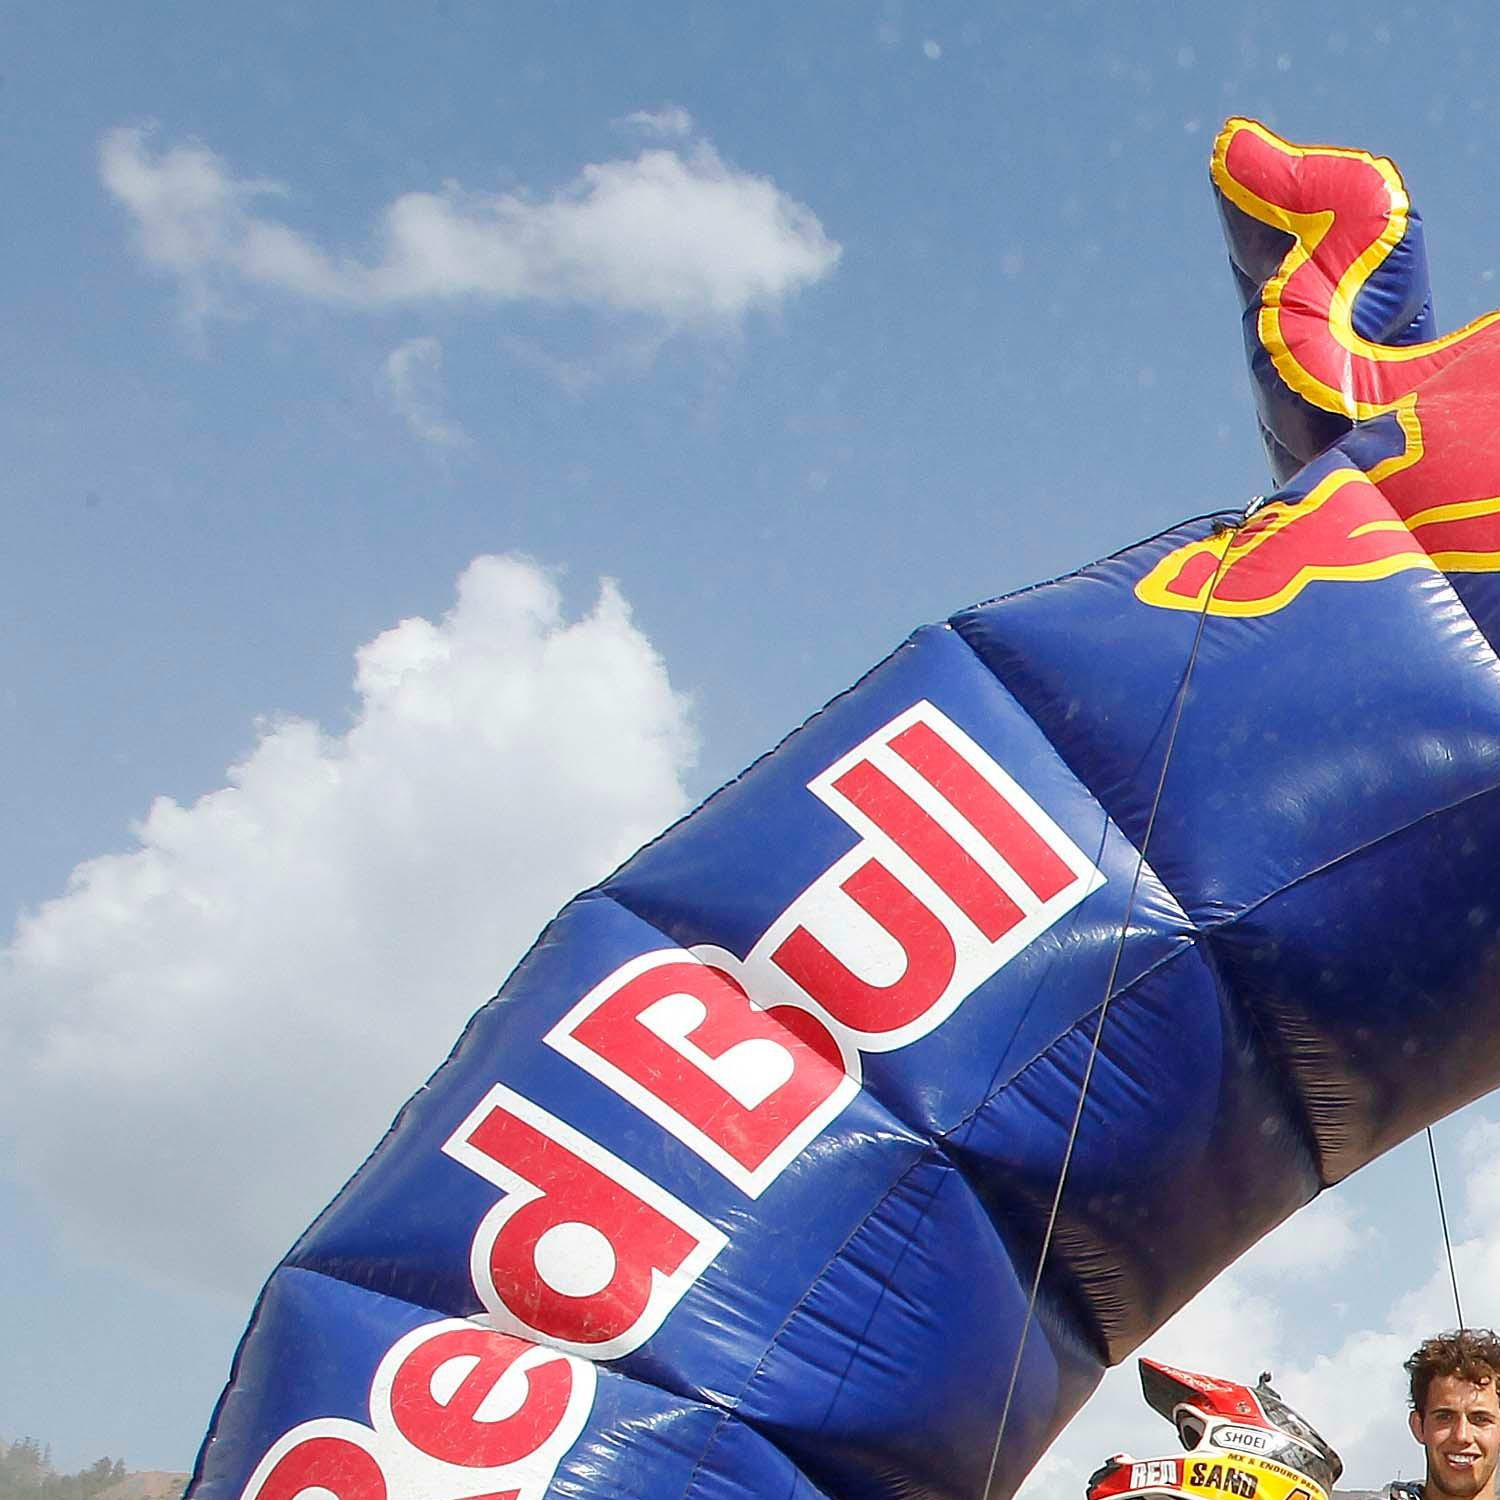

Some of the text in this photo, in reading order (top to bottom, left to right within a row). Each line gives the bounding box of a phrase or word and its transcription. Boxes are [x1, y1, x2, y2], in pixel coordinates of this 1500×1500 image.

[556, 706, 1092, 1186] Bull
[1224, 1431, 1267, 1450] SHOEI
[1189, 1462, 1259, 1500] SAND
[1259, 1461, 1299, 1482] ENDURO
